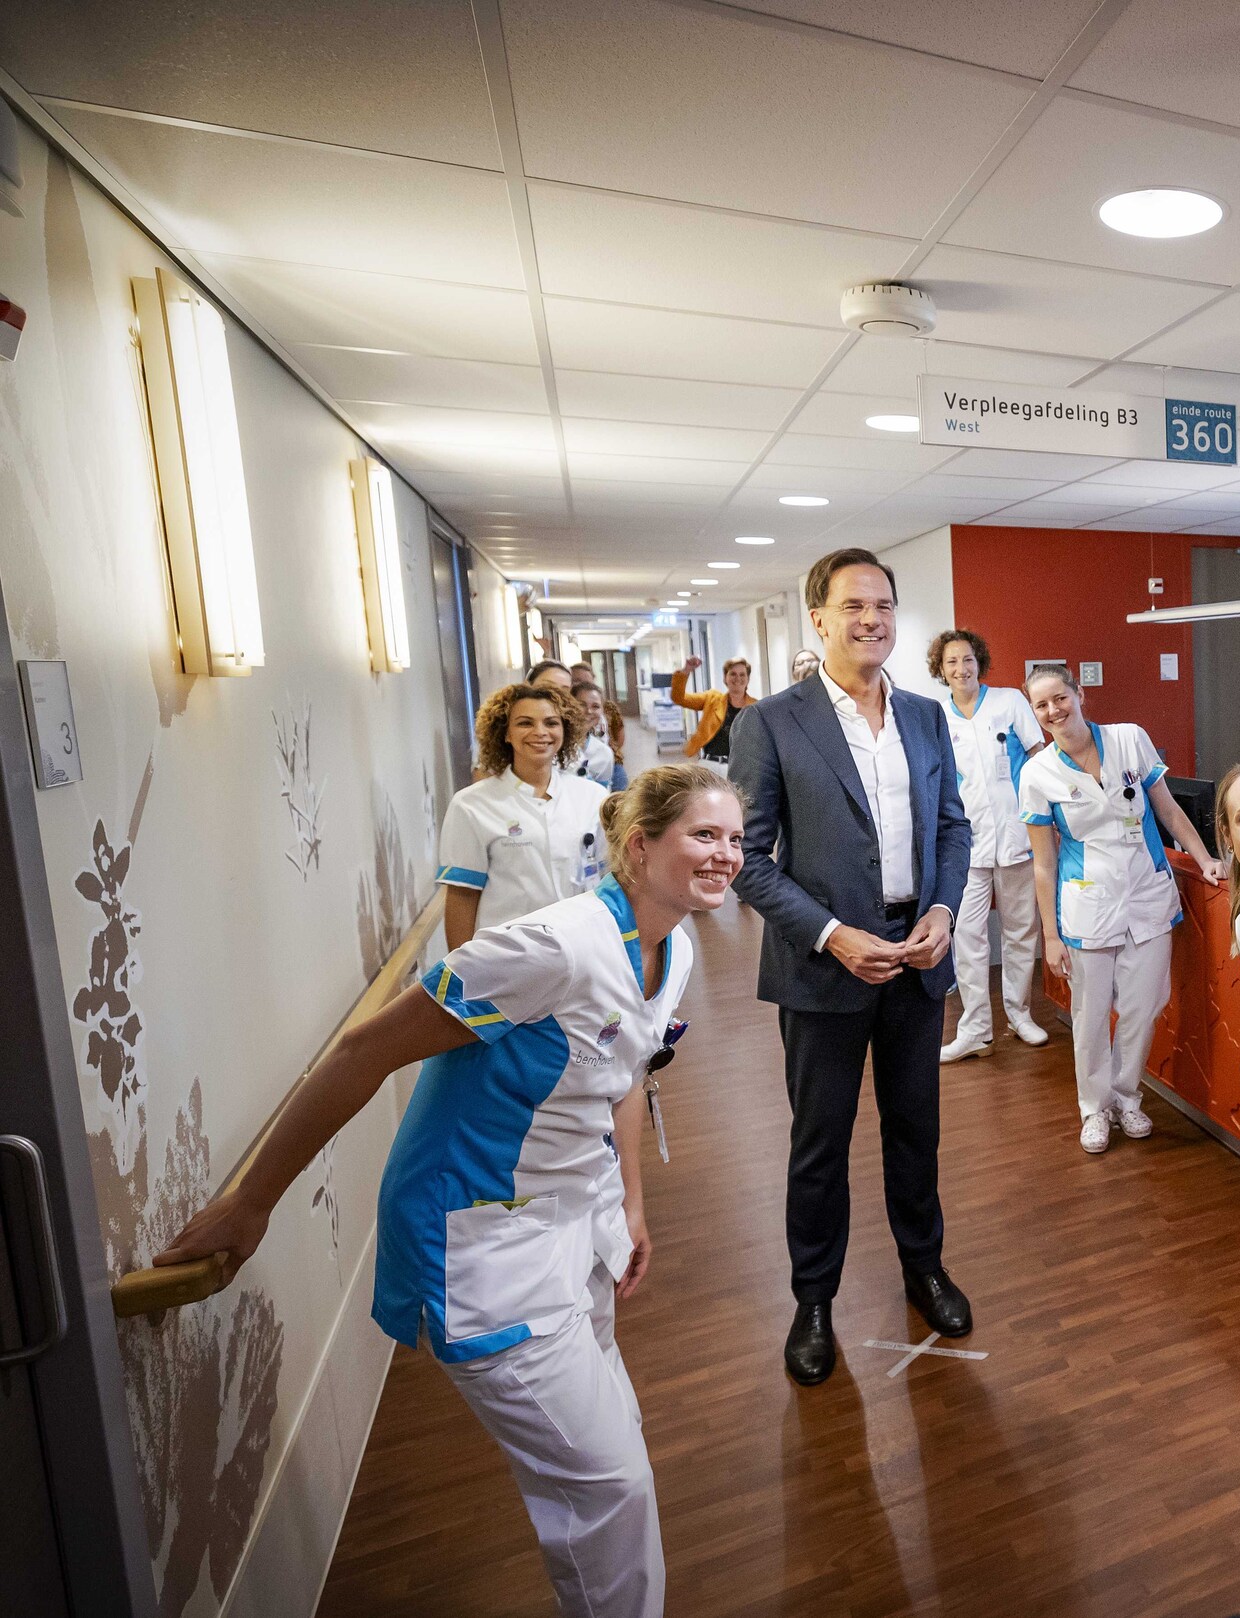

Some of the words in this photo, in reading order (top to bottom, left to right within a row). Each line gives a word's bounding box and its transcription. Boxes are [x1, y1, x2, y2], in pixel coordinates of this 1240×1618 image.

[943, 391, 1110, 428] Verpleegafdeling
[1117, 408, 1139, 426] B3
[945, 418, 981, 434] West
[1172, 404, 1201, 417] einde
[1204, 407, 1232, 420] route
[1171, 418, 1234, 454] 360
[60, 721, 73, 755] 3
